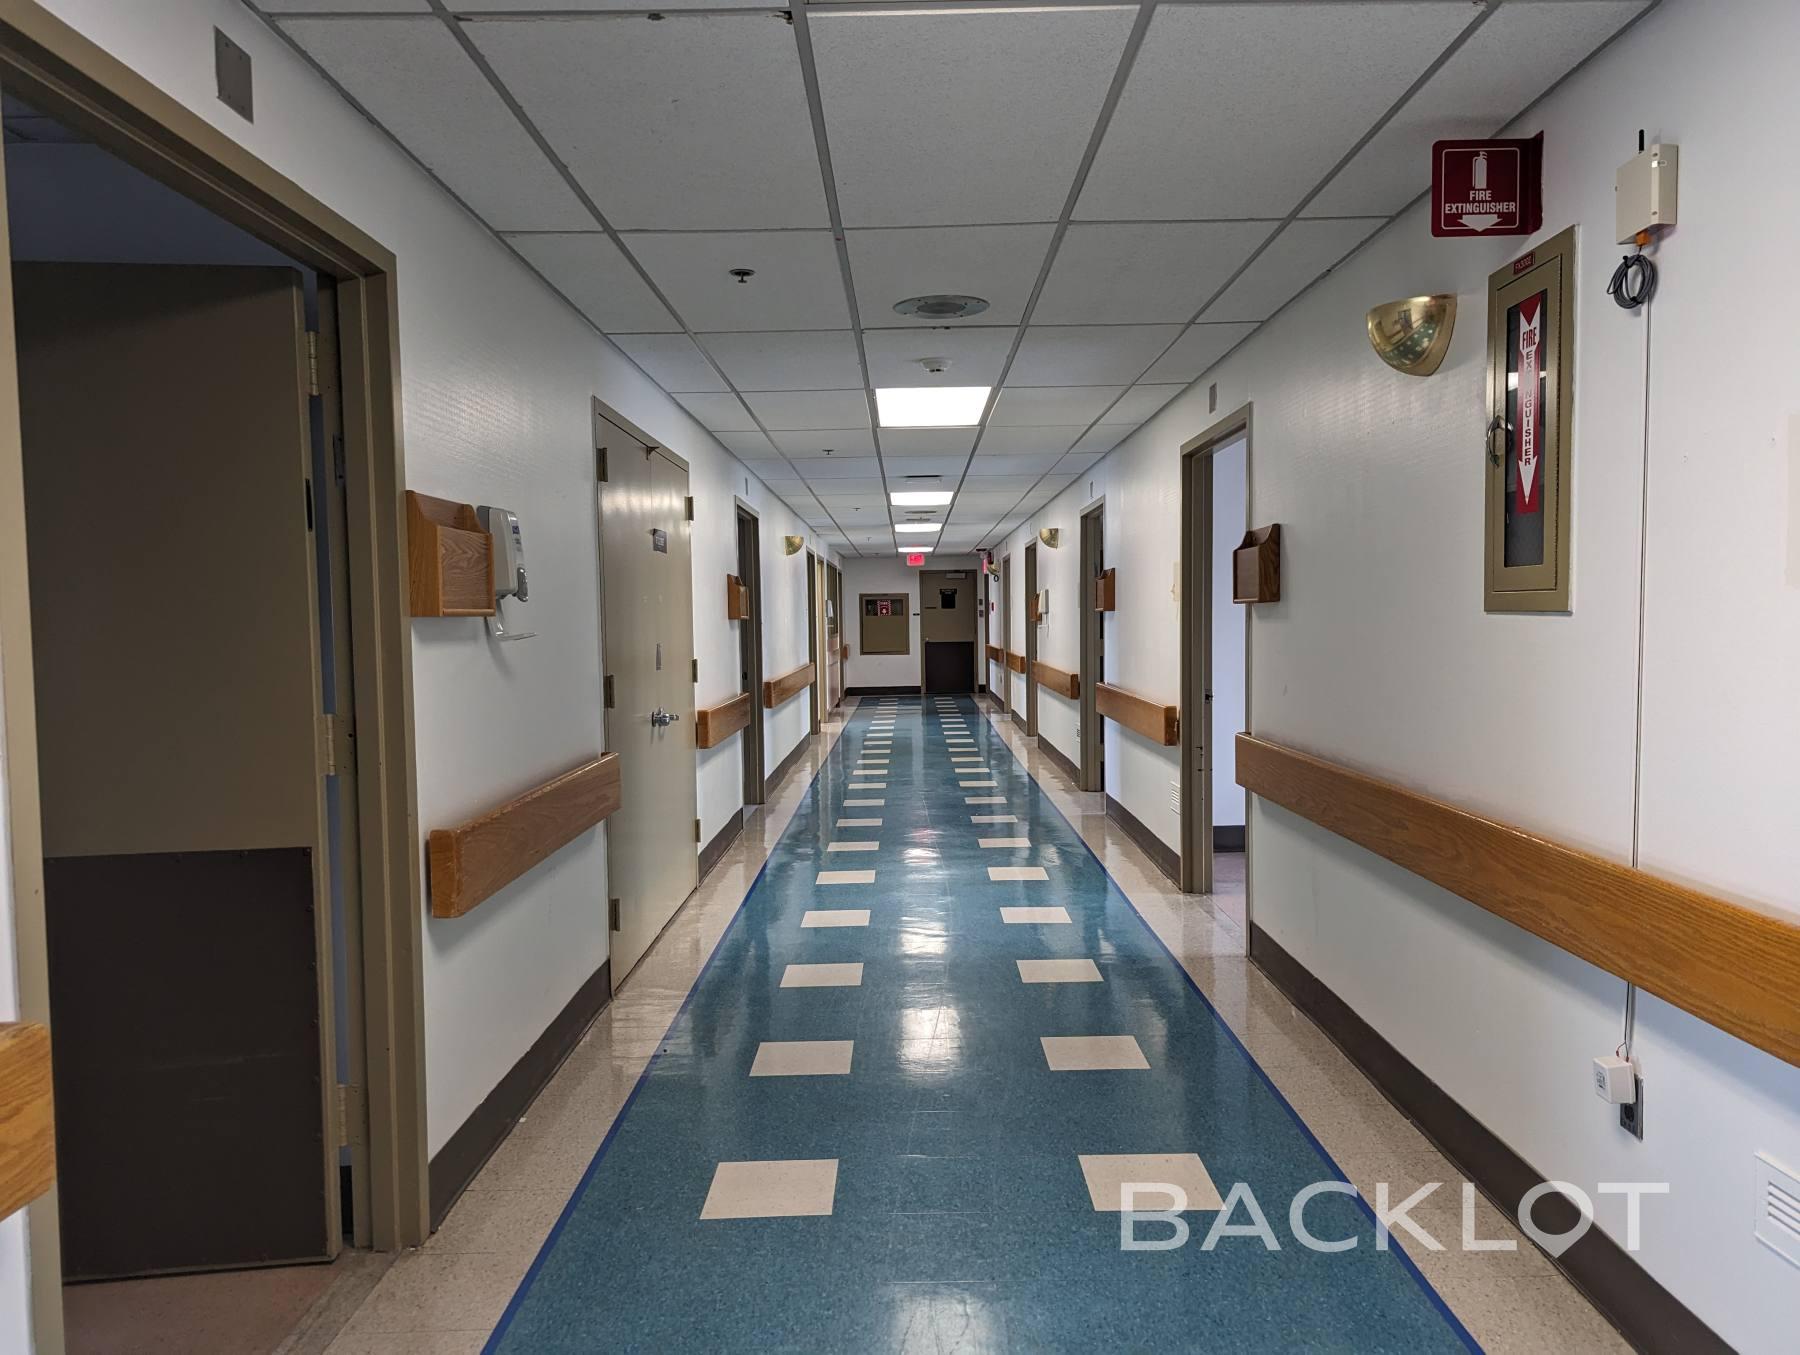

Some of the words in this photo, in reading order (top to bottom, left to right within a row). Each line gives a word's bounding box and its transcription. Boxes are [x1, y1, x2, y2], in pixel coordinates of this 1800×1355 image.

[1469, 190, 1492, 201] FIRE
[1445, 202, 1516, 214] EXTINGUISHER
[1522, 327, 1537, 350] FIRE
[1524, 350, 1533, 467] EXNGUISHER
